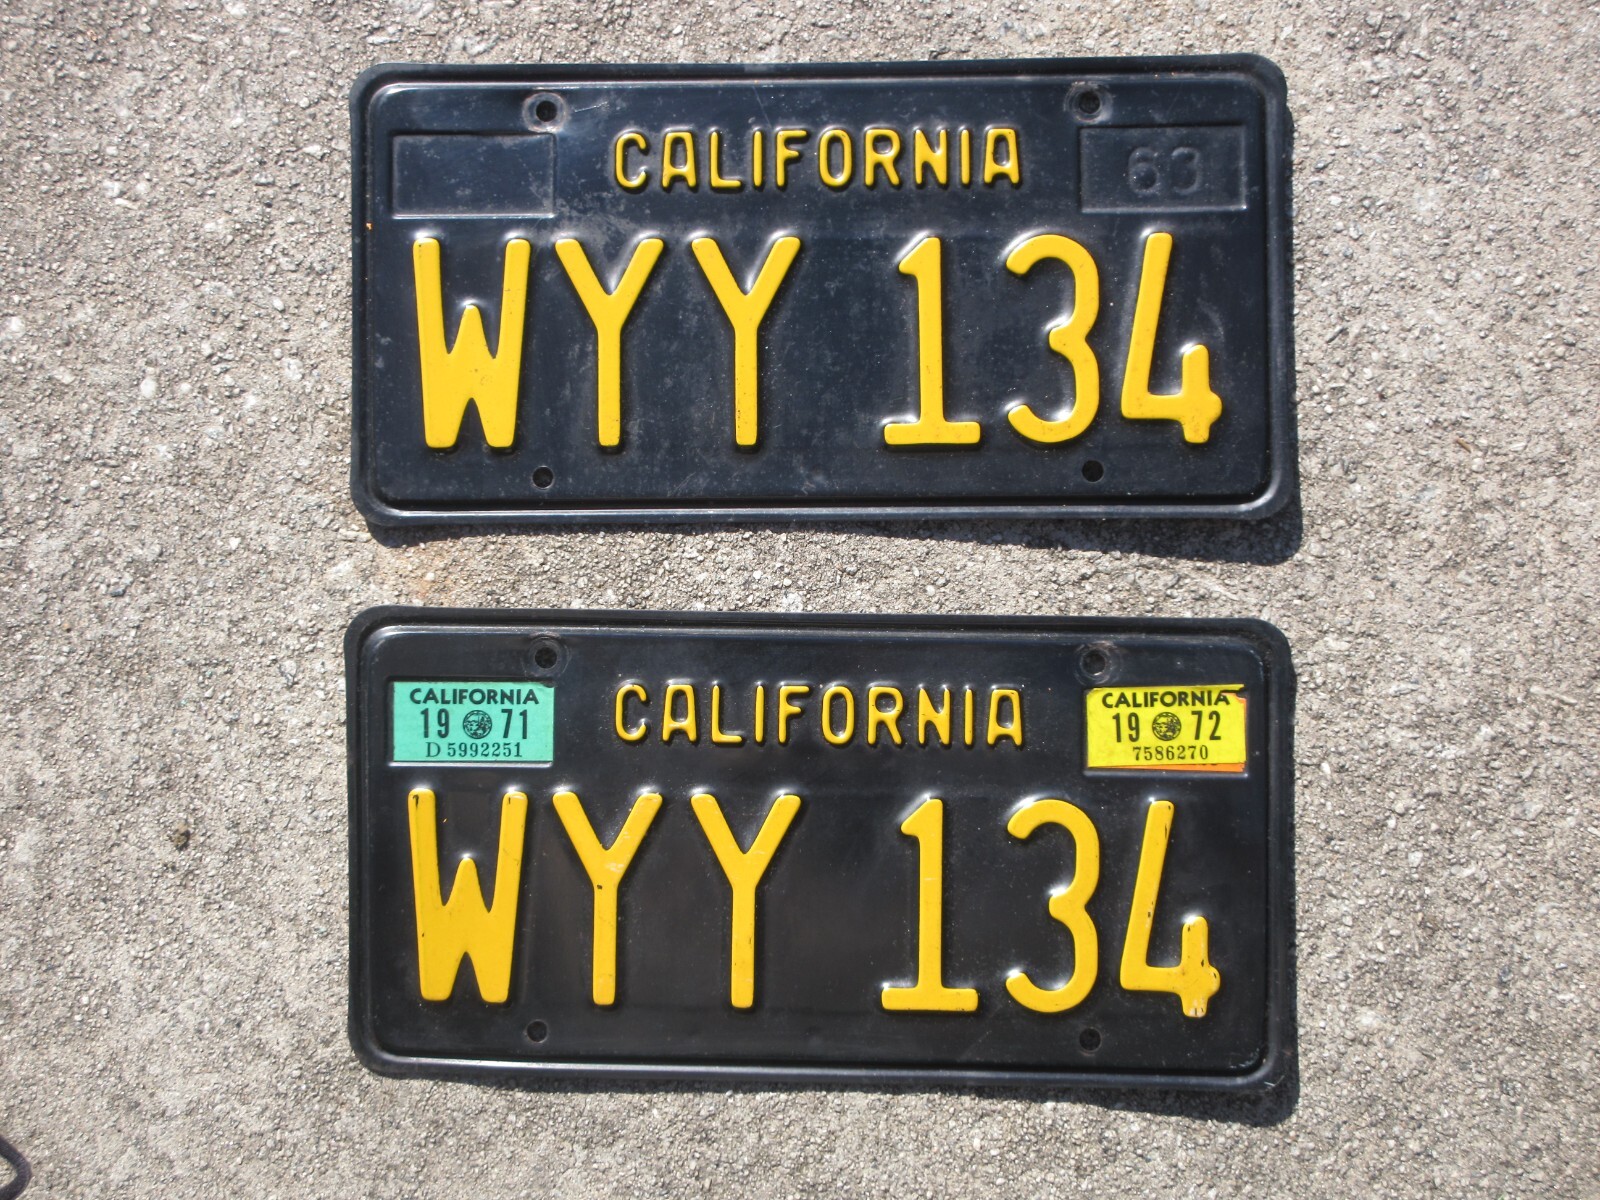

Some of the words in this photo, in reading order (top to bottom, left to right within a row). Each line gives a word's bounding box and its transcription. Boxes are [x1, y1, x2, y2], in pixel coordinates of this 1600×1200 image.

[614, 127, 1021, 189] CALIFORNIA
[1128, 146, 1202, 196] 63
[411, 235, 802, 450] WYY
[883, 231, 1223, 446] 134
[409, 687, 540, 705] CALIFORNIA
[614, 683, 1023, 747] CALIFORNIA
[1101, 690, 1231, 709] CALIFORNIA
[420, 707, 450, 739] 19
[500, 708, 528, 740] 71
[1112, 711, 1140, 743] 19
[1190, 710, 1222, 741] 72
[1132, 744, 1209, 761] 7586270
[406, 787, 802, 1010] WYY
[880, 798, 1222, 1019] 134
